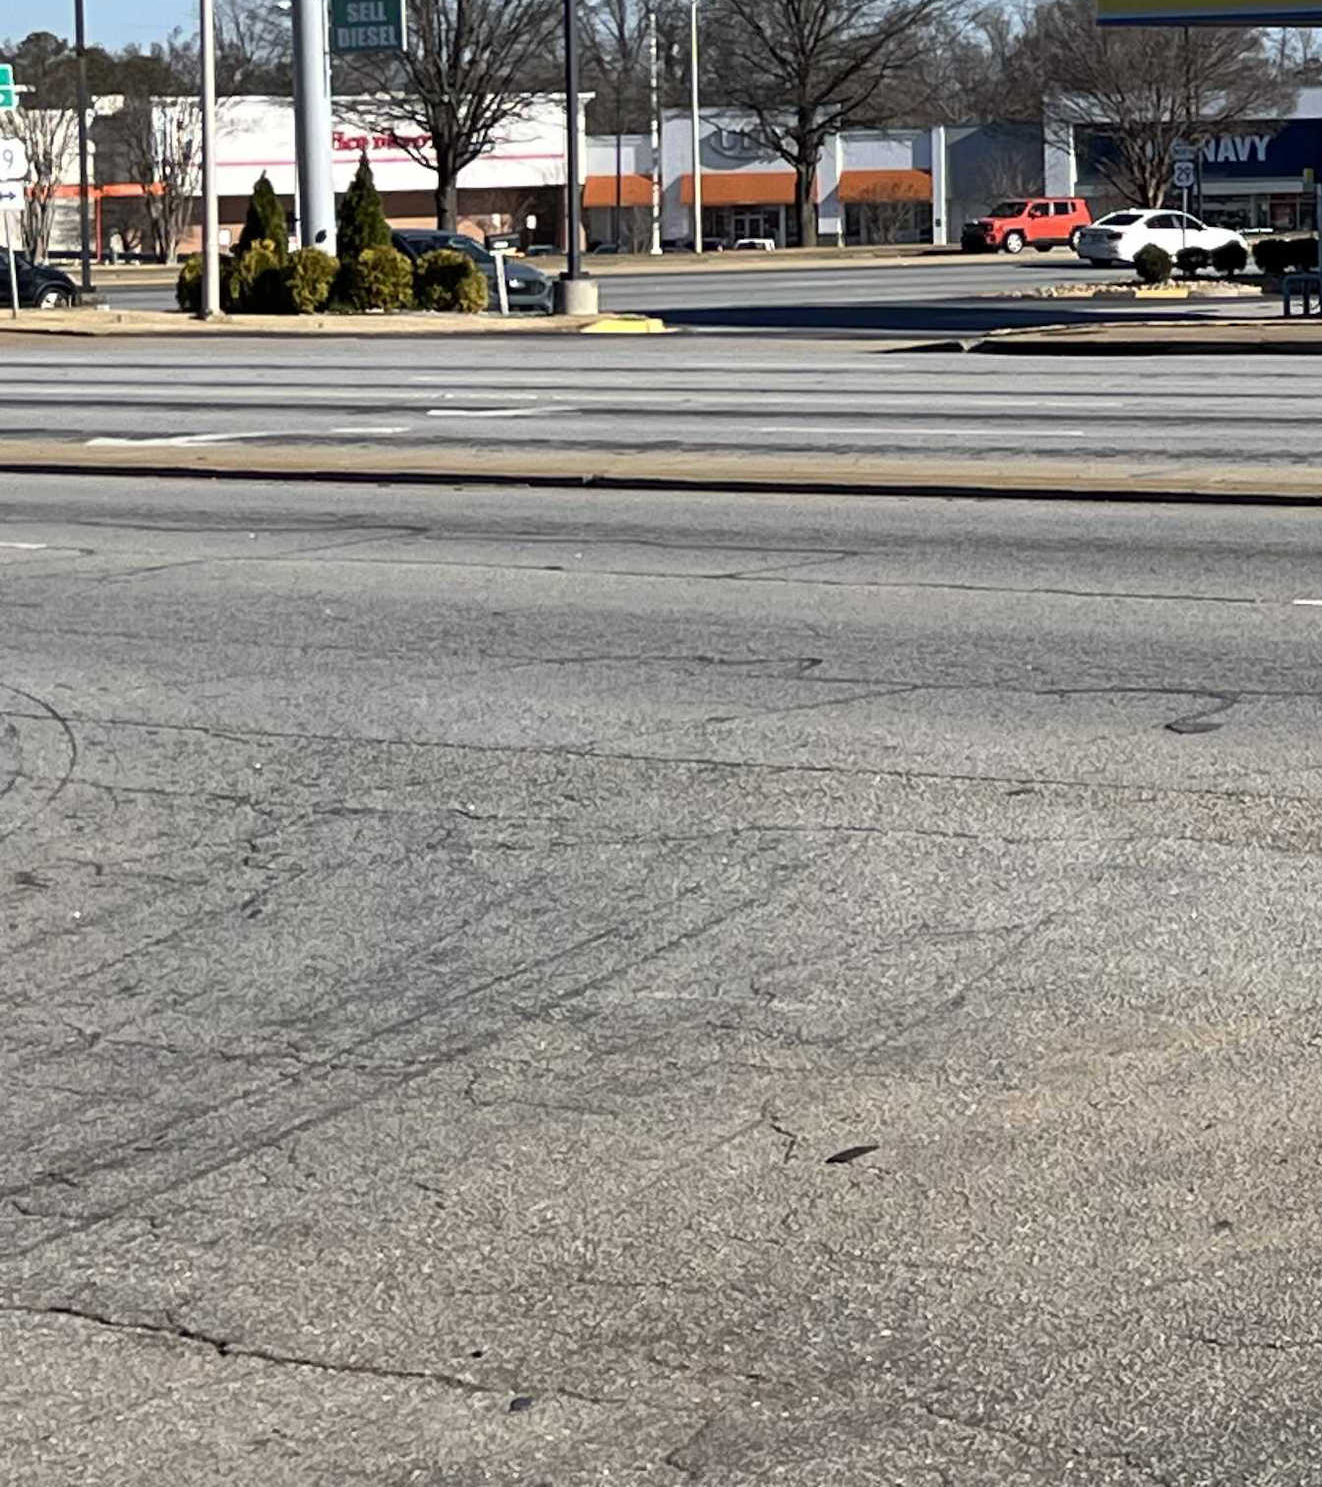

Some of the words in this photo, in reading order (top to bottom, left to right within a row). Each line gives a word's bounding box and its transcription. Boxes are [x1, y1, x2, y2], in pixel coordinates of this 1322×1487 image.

[346, 0, 387, 23] SELL
[337, 25, 399, 48] DIESEL
[1202, 133, 1271, 162] NAVY
[1176, 165, 1192, 183] 29
